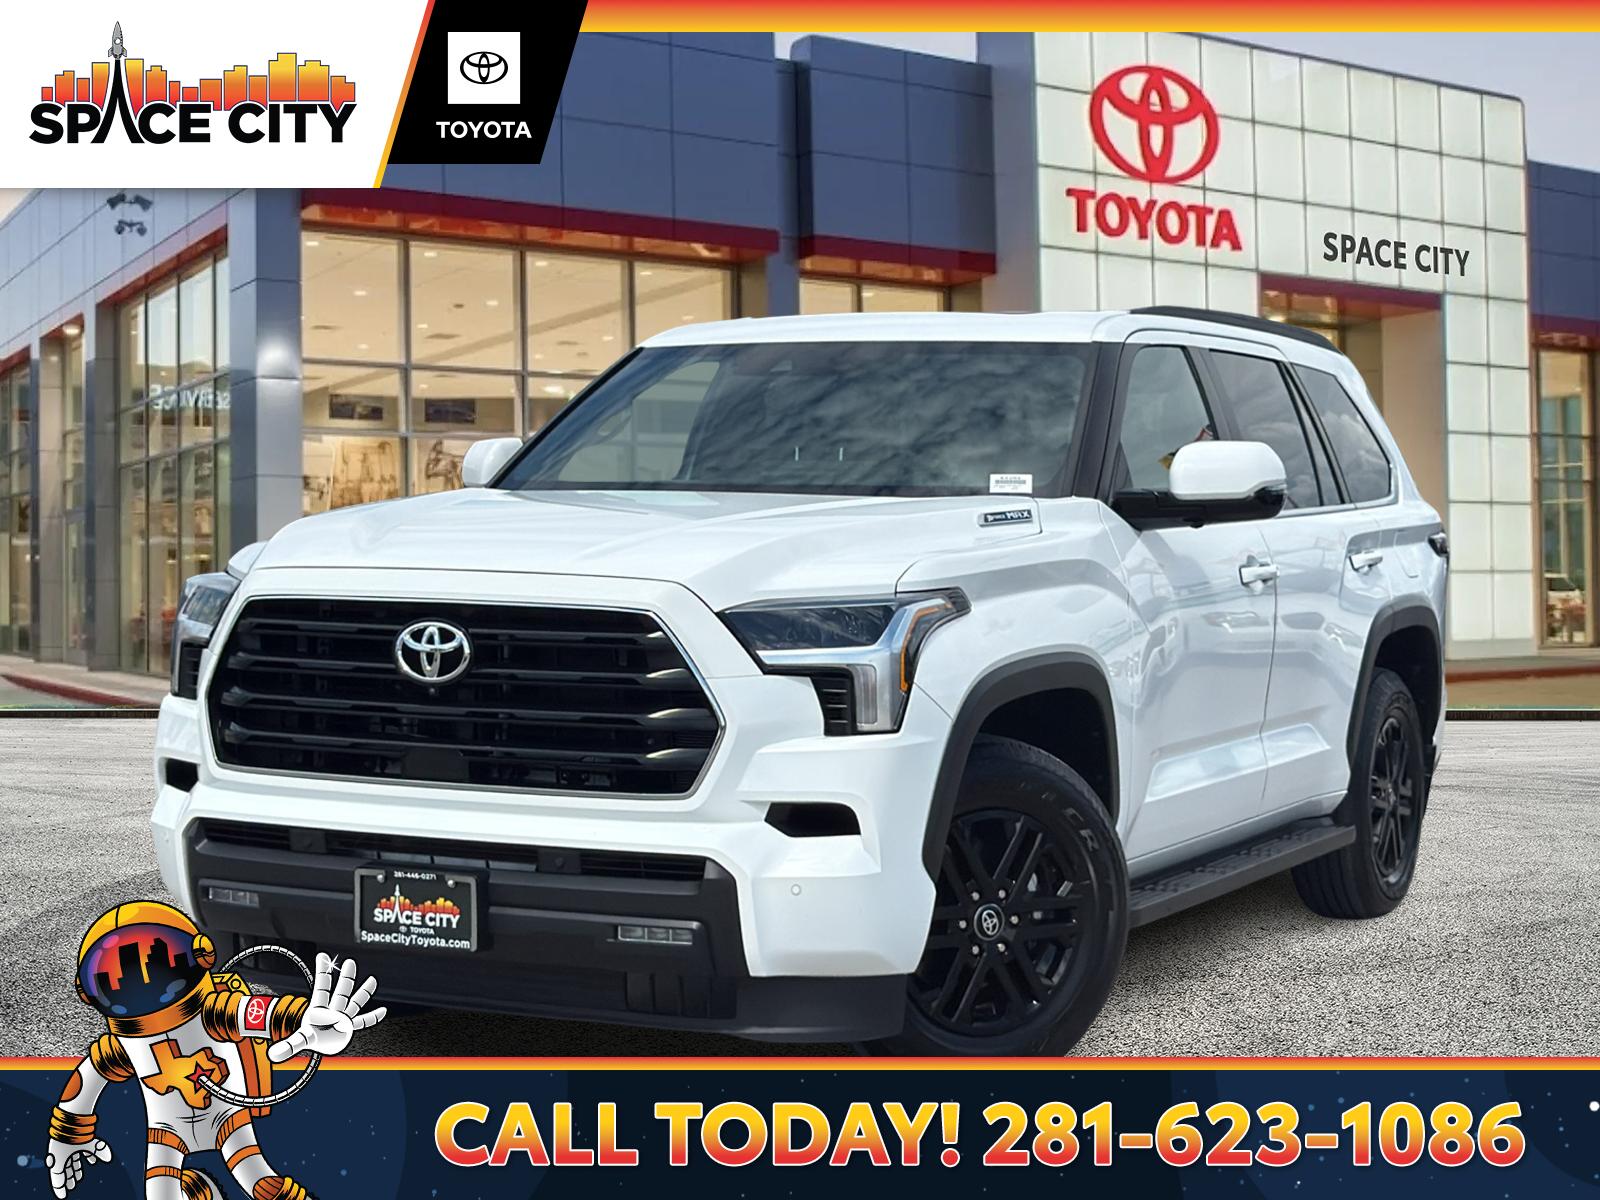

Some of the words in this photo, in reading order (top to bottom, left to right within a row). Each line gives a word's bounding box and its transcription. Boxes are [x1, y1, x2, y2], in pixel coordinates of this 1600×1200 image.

[1065, 186, 1243, 252] TOYOTA
[1323, 231, 1407, 270] SPACE
[1414, 244, 1470, 277] CITY
[373, 903, 422, 925] SPACE
[425, 911, 461, 929] CITY
[361, 930, 471, 949] SpaceCityToyota.com
[410, 926, 435, 935] TOYOTA
